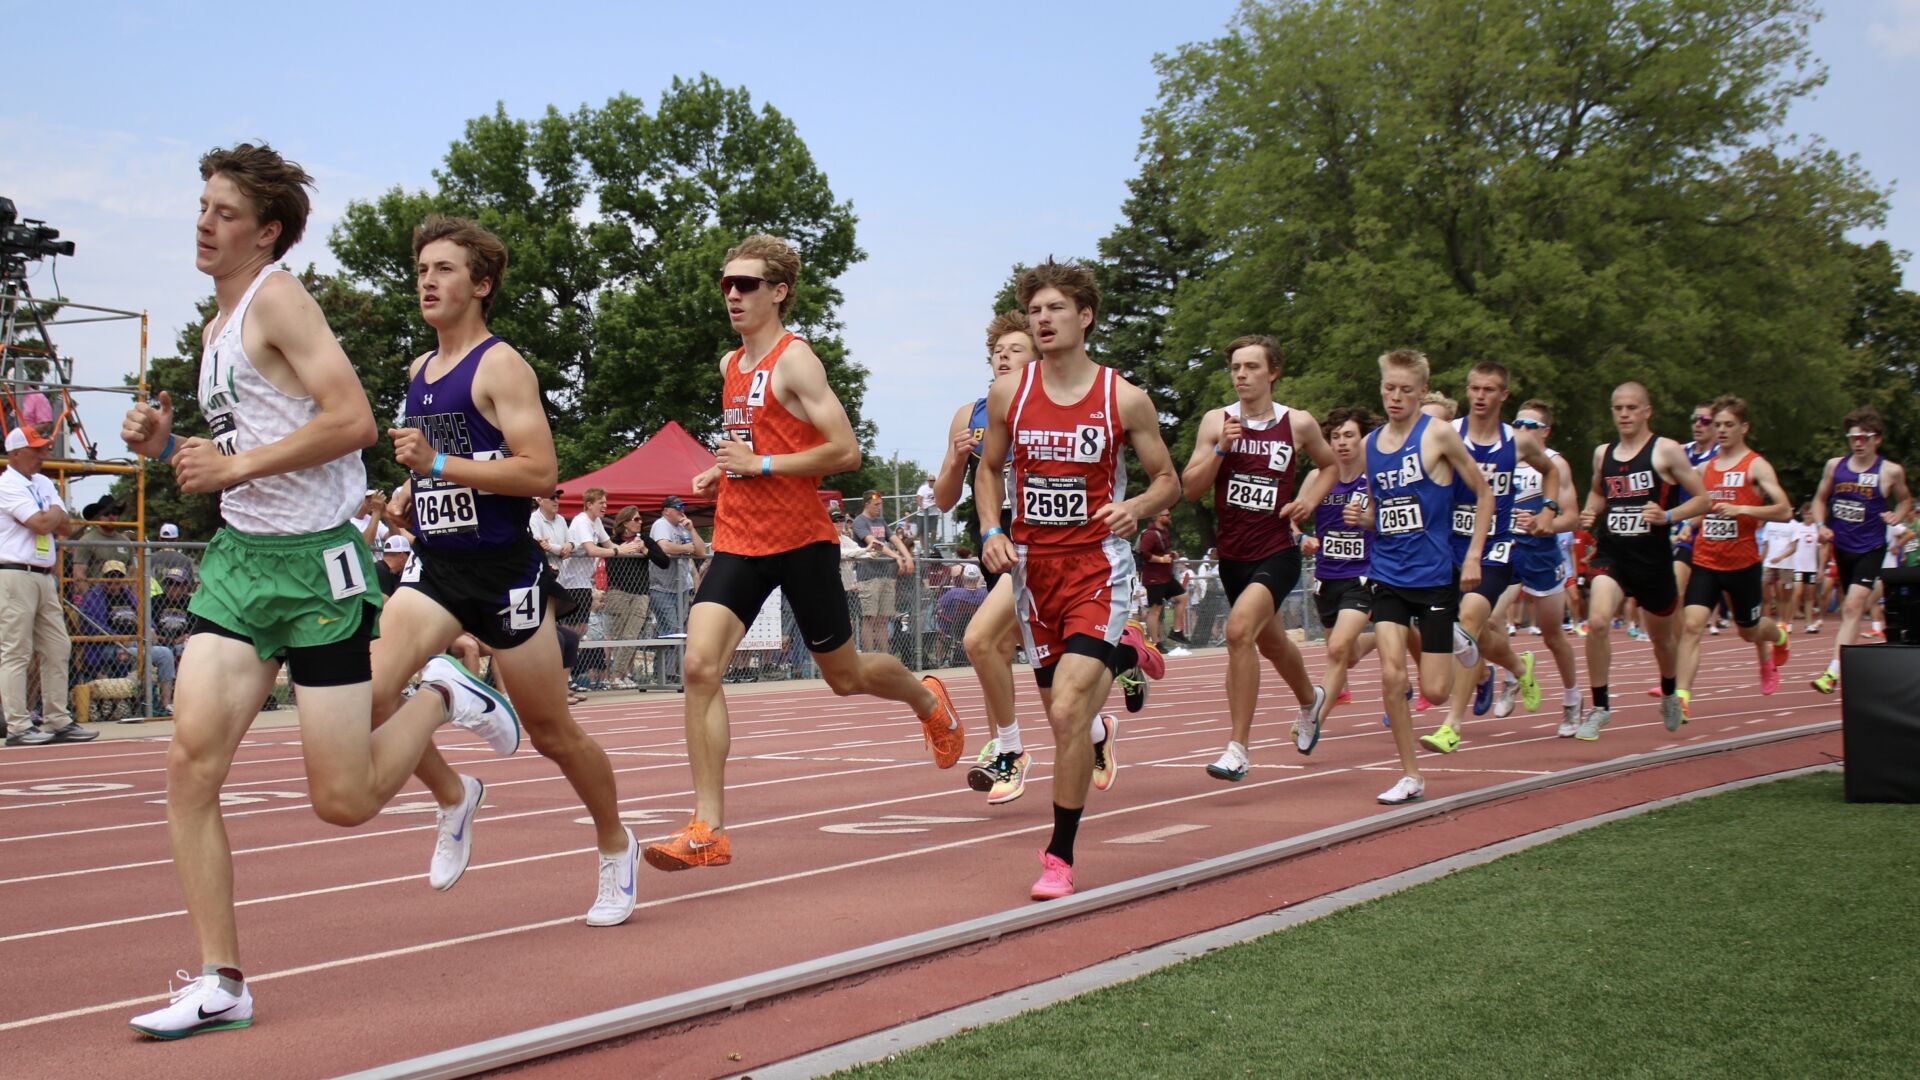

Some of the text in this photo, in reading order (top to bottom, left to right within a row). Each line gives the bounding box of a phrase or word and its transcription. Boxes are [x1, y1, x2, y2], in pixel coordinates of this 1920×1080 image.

[751, 372, 763, 398] 2
[1018, 430, 1106, 447] BRITT
[1080, 427, 1098, 456] 8
[1231, 439, 1285, 455] MADIS
[1027, 445, 1077, 462] HECL
[1274, 446, 1289, 465] 5
[1407, 456, 1416, 477] 3
[1522, 475, 1537, 488] 14
[1632, 473, 1649, 489] 19
[1727, 473, 1741, 485] 17
[1026, 491, 1085, 518] 2592
[1229, 484, 1275, 507] 2844
[418, 493, 473, 525] 2648
[1382, 508, 1418, 529] 2951
[1611, 516, 1649, 531] 2674
[1325, 539, 1362, 556] 2566
[1494, 543, 1506, 560] 9
[332, 551, 358, 591] 1
[516, 589, 535, 620] 4
